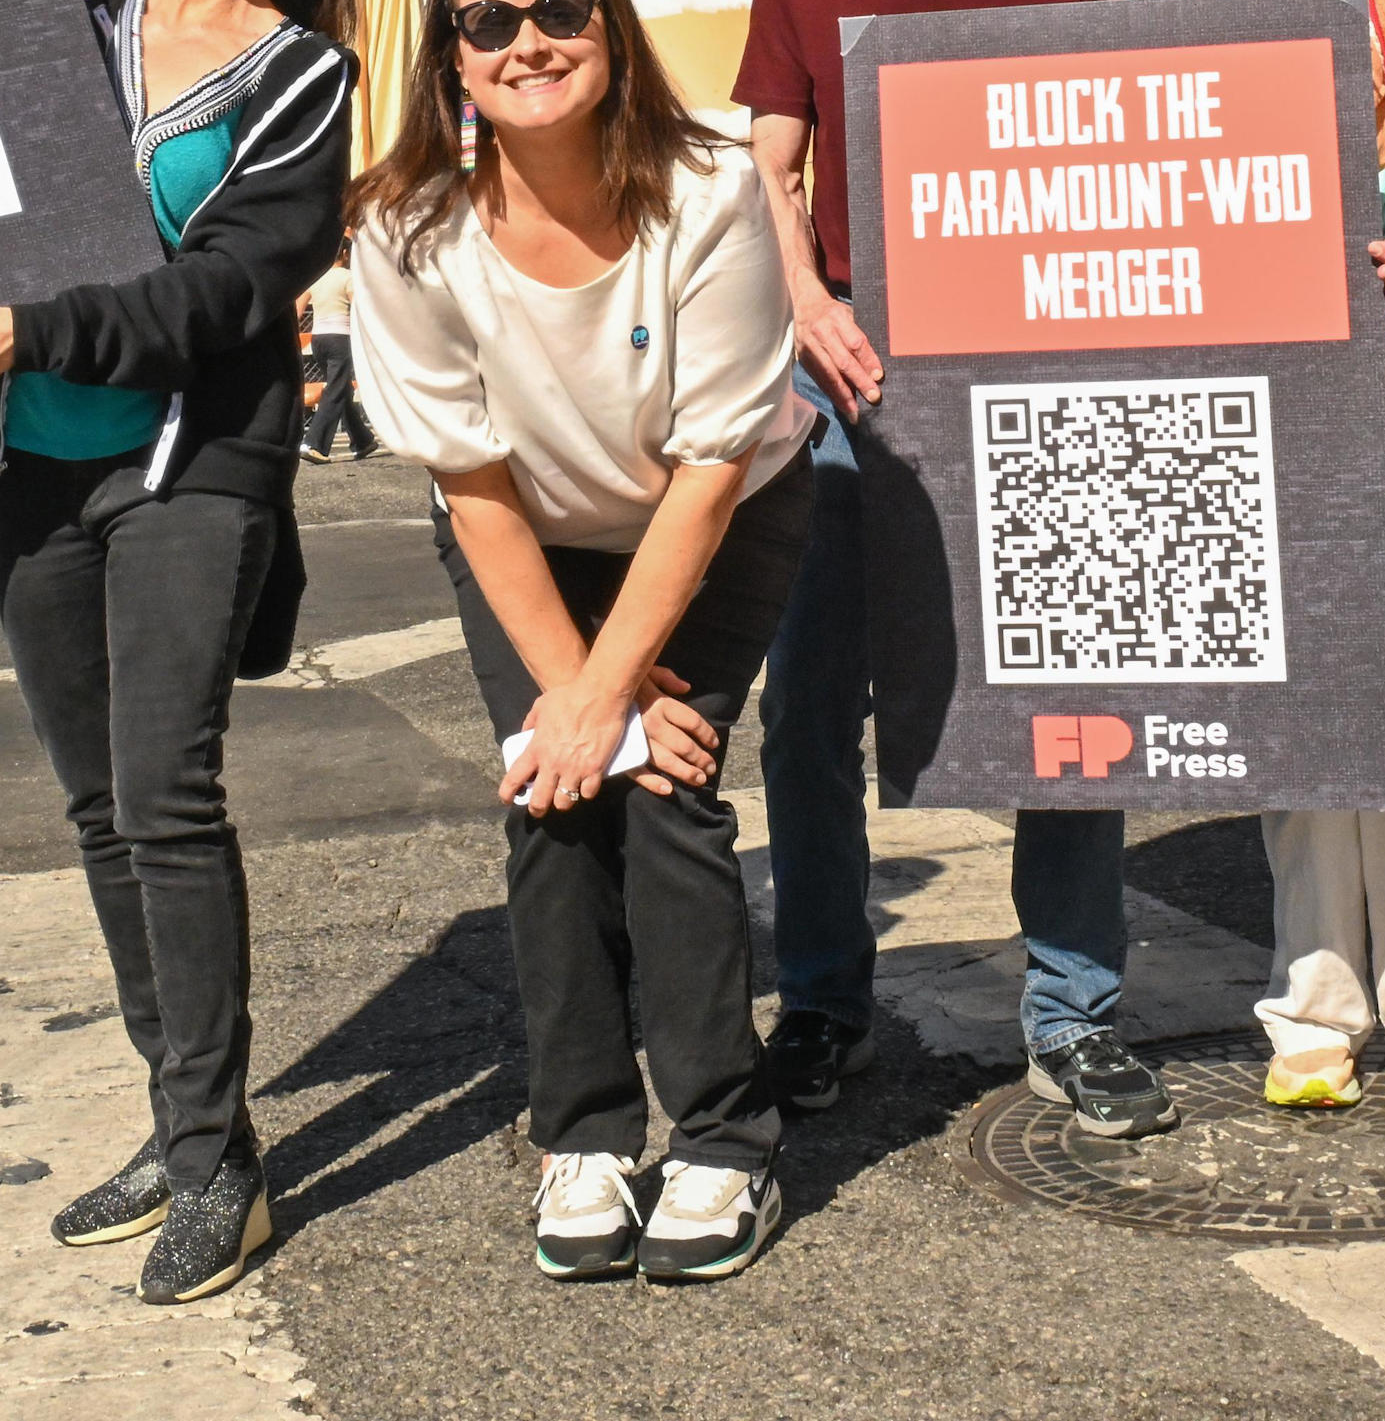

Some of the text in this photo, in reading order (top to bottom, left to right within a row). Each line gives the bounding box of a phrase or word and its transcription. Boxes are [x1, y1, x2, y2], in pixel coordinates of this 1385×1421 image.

[986, 71, 1223, 149] BLOCK THE
[910, 154, 1312, 239] PARAMOUNT-WBD
[1022, 247, 1203, 320] MERGER
[1032, 715, 1134, 778] FP
[1144, 715, 1228, 746] Free
[1146, 747, 1247, 778] Press
